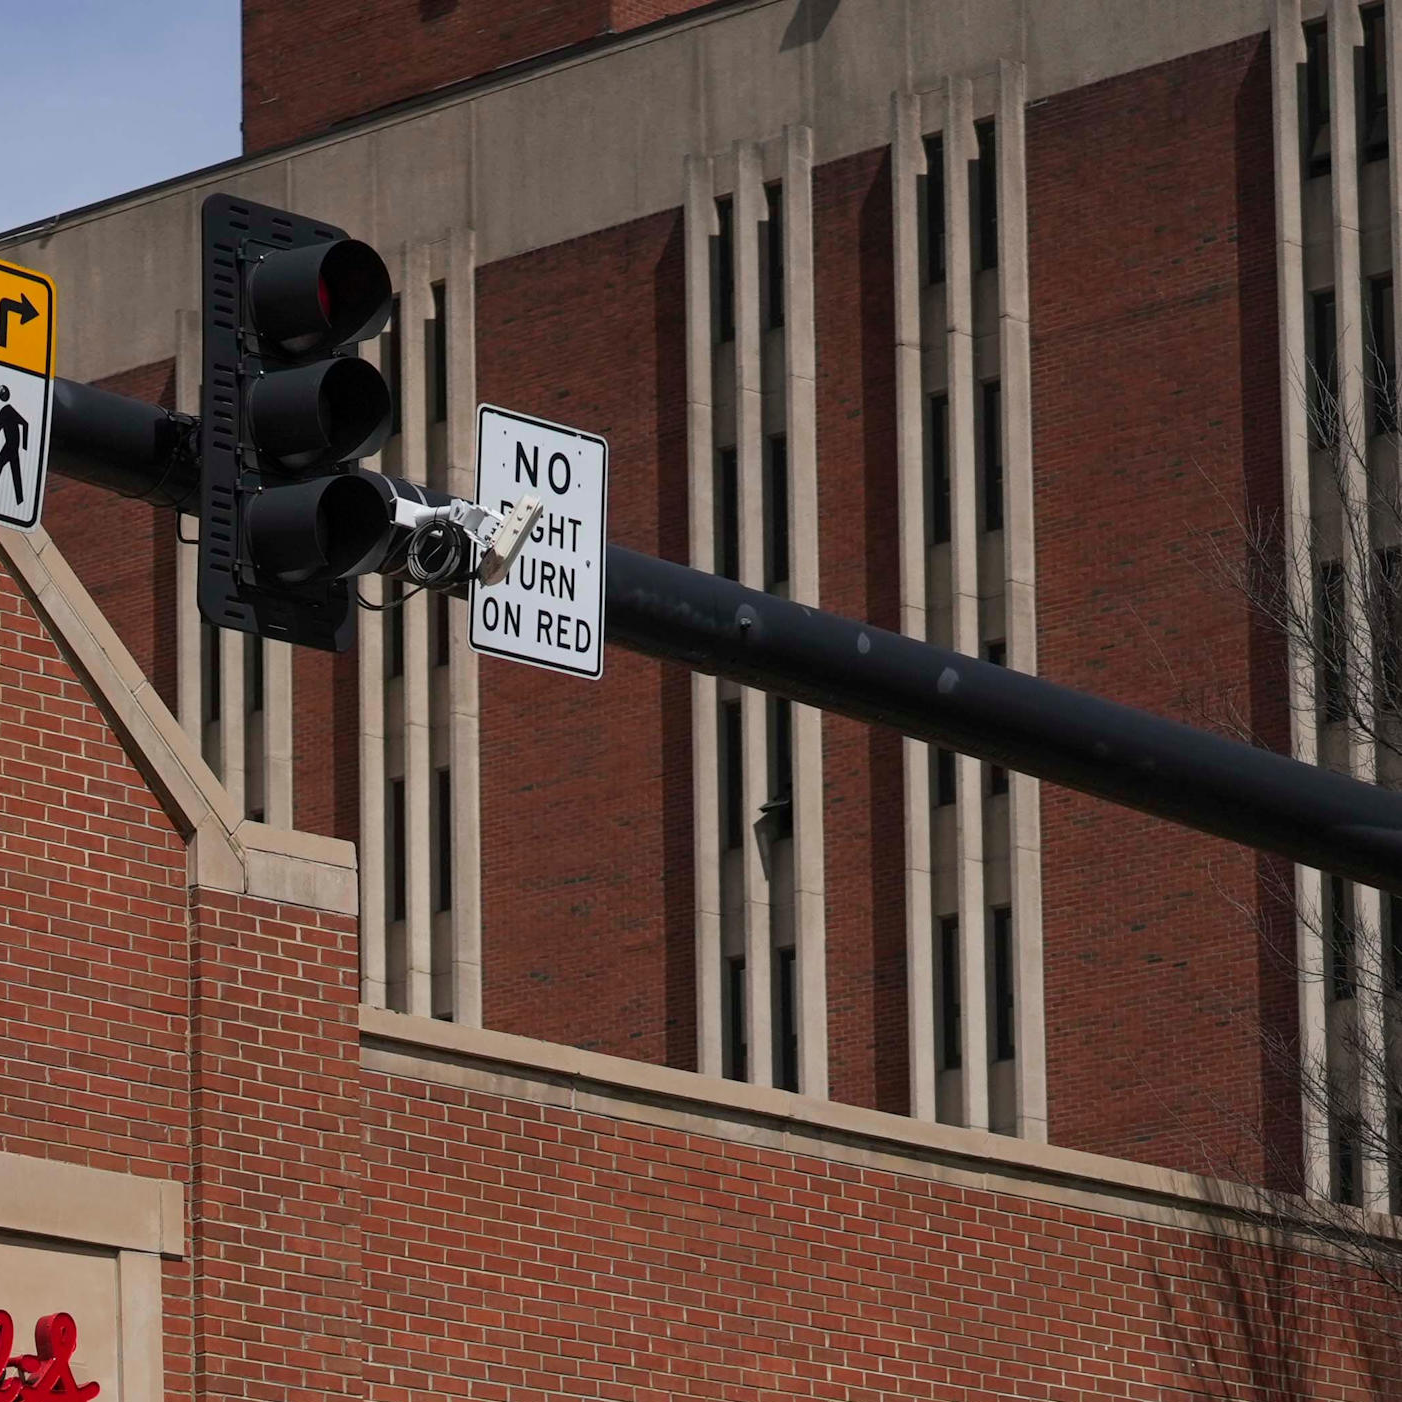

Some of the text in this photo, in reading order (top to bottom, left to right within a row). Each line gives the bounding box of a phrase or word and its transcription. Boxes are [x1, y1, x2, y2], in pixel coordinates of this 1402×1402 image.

[515, 441, 571, 495] NO
[482, 597, 591, 653] ON RED
